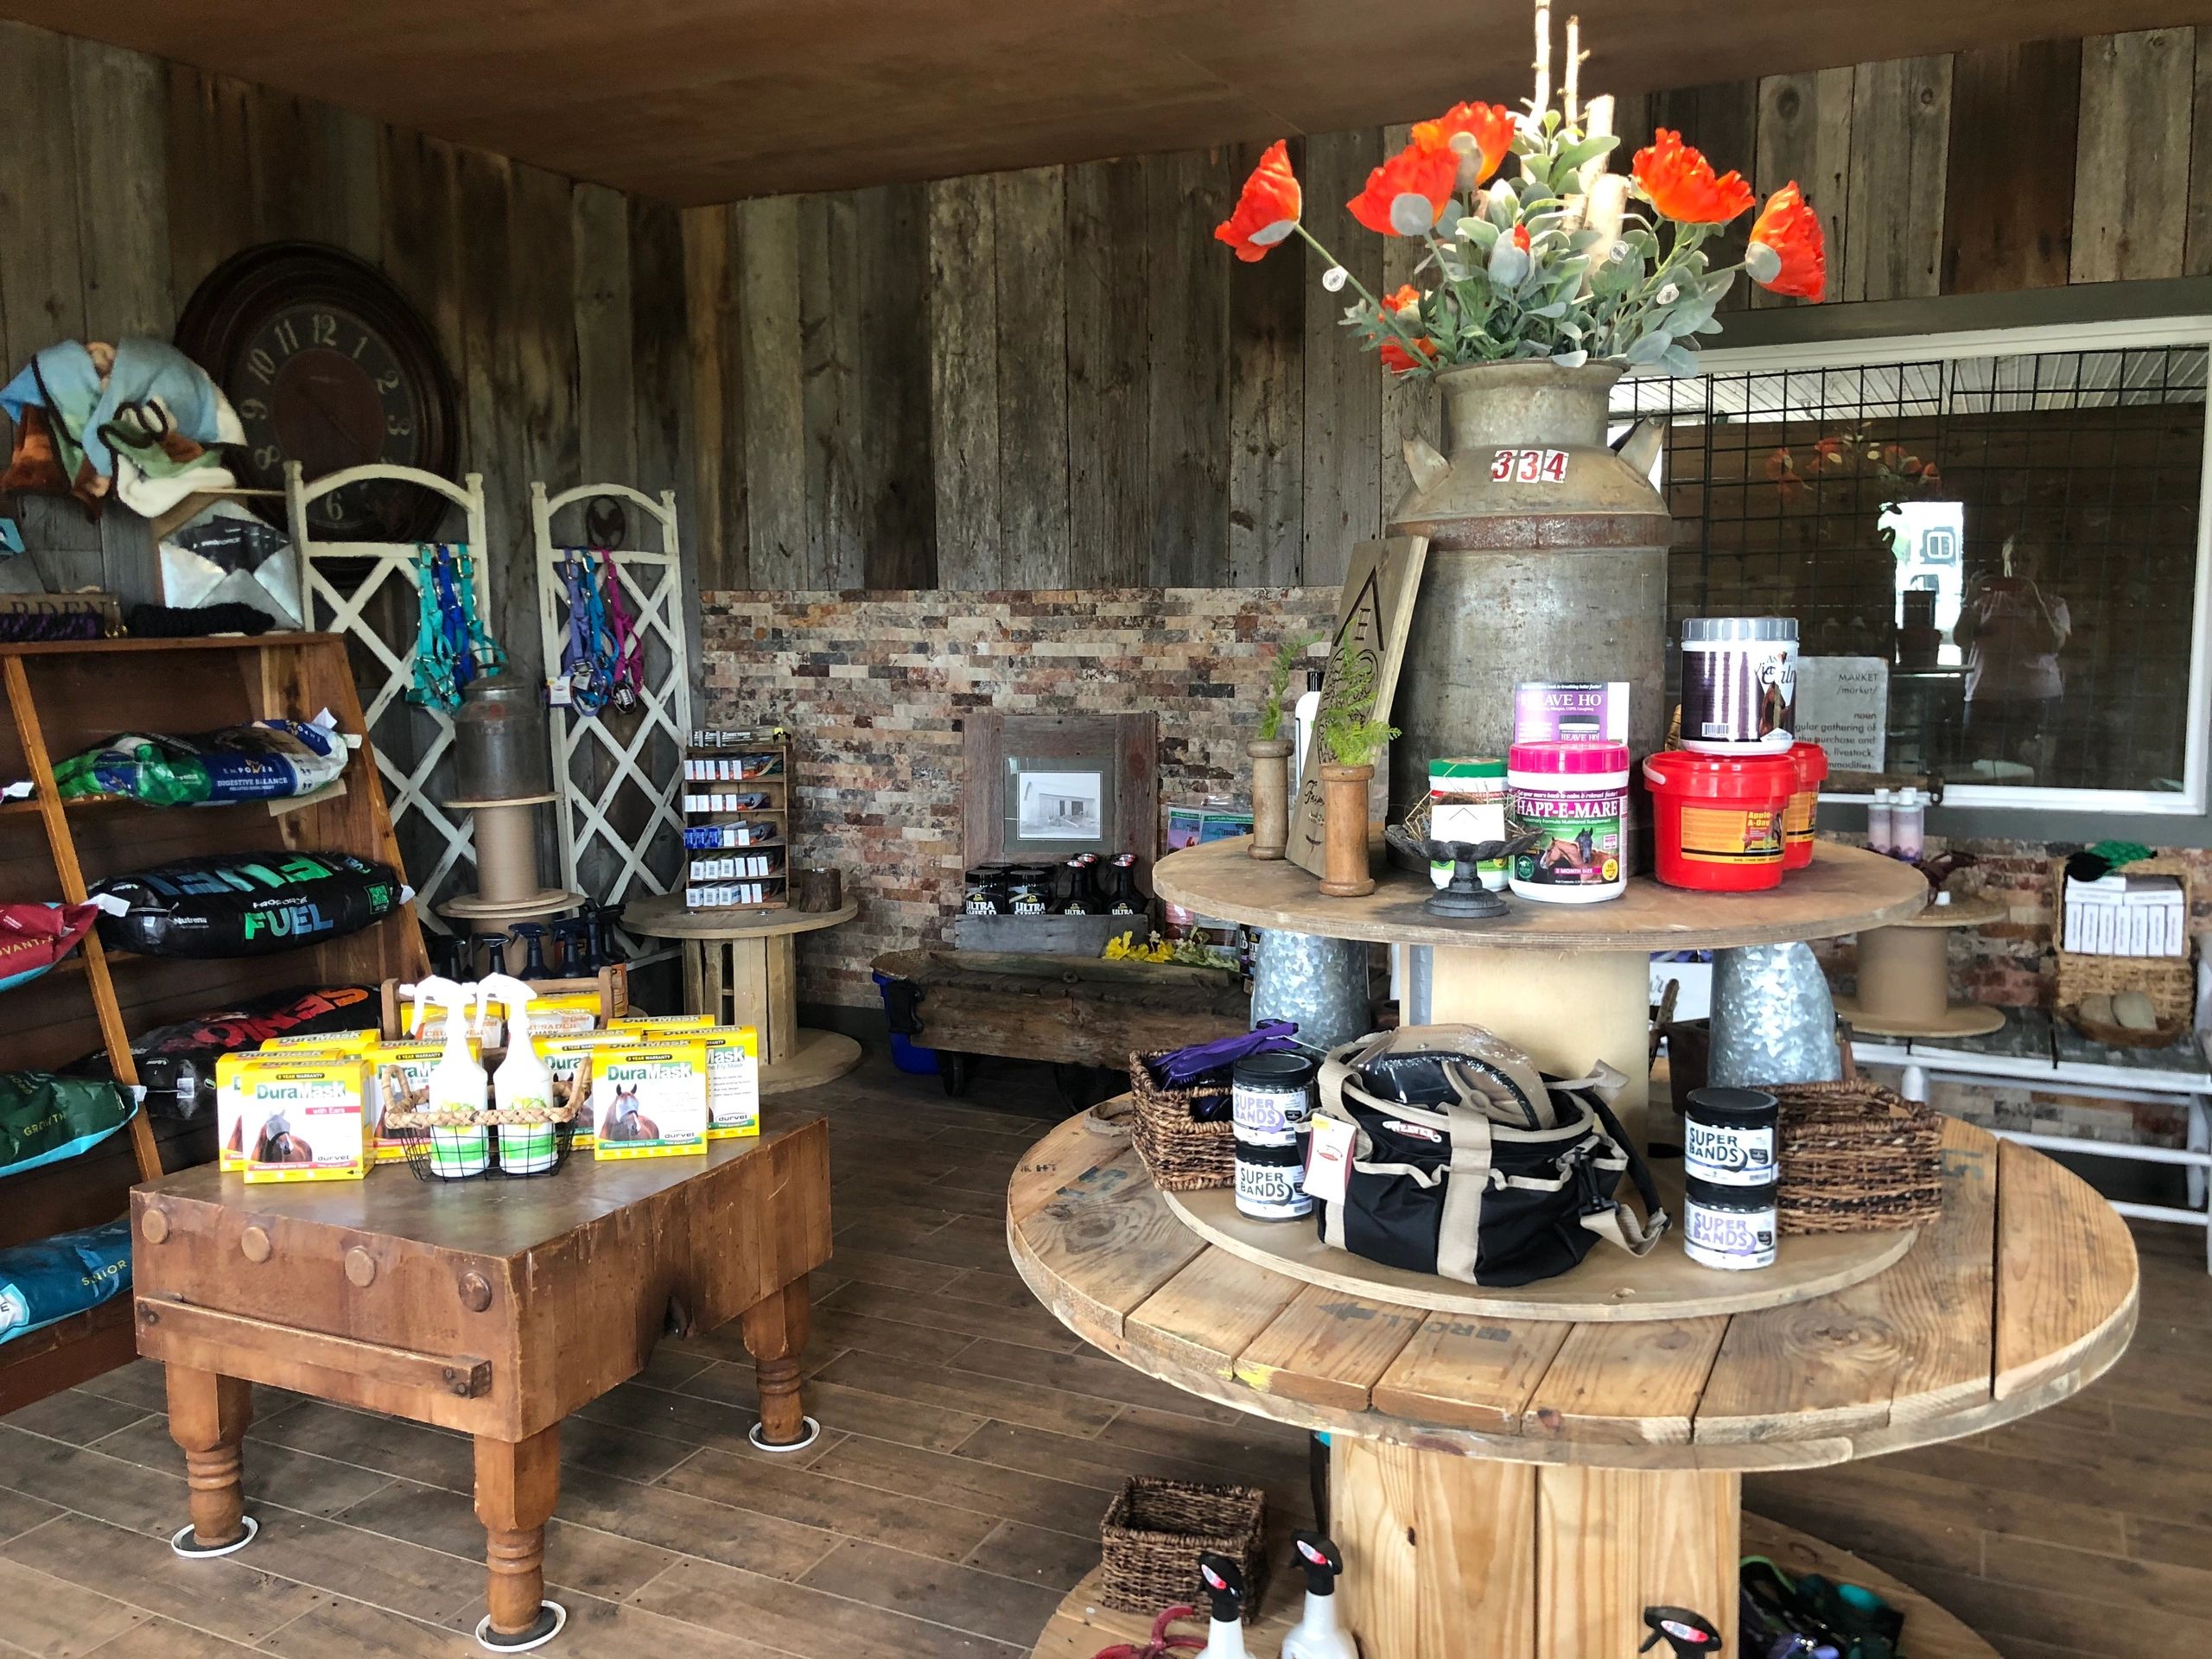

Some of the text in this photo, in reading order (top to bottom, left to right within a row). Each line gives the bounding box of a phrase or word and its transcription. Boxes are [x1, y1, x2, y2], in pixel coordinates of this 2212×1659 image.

[273, 319, 300, 356] 11
[313, 314, 338, 346] 12
[352, 336, 368, 359] 1
[246, 347, 276, 385] 10
[375, 371, 399, 395] 2
[241, 397, 268, 421] 9
[387, 415, 412, 436] 3
[254, 444, 282, 471] 8
[1492, 450, 1565, 481] 334
[1795, 721, 1877, 733] gular gathering of
[1815, 734, 1855, 744] purchase
[1517, 799, 1618, 818] HAPP-E-MARE
[966, 900, 995, 911] ULTRA
[1015, 901, 1046, 912] ULTRA
[245, 903, 334, 940] FUEL
[608, 1062, 693, 1081] DuraMask
[257, 1080, 346, 1100] DuraMask
[1235, 1092, 1274, 1110] SUPER
[718, 1114, 748, 1122] durvet
[1235, 1108, 1276, 1125] BANDS
[1689, 1127, 1738, 1147] SUPER
[1688, 1143, 1738, 1163] BANDS
[1240, 1166, 1284, 1185] SUPER
[1240, 1181, 1285, 1198] BANDS
[1694, 1211, 1747, 1231] SUPER
[1694, 1224, 1748, 1247] BANDS
